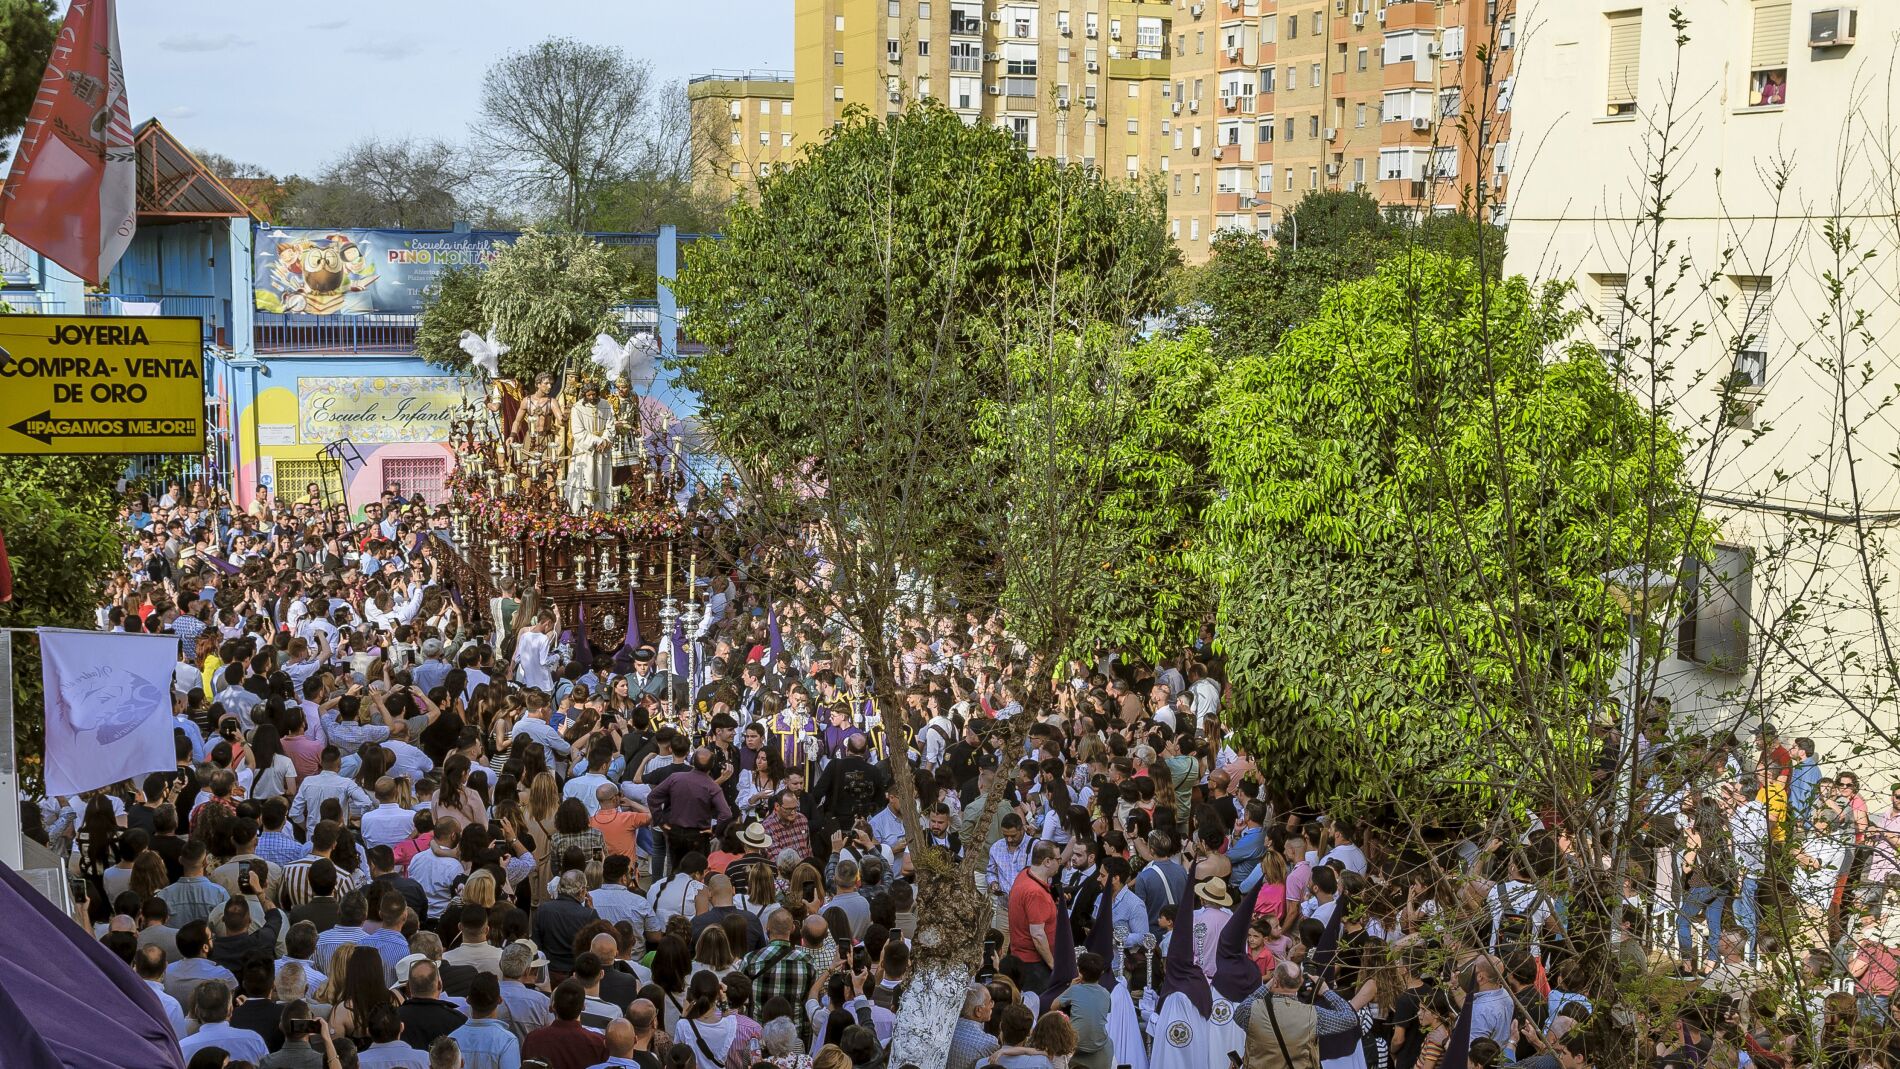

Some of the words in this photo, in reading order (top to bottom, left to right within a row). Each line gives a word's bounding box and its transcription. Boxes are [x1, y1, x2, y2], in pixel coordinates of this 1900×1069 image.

[388, 249, 431, 264] PINO
[433, 250, 502, 264] MONTAN
[411, 239, 451, 250] Escuela
[453, 240, 491, 253] infantil
[48, 325, 150, 346] JOYERIA
[0, 357, 118, 378] COMPRA-
[124, 358, 200, 379] VENTA
[53, 383, 83, 403] DE
[90, 383, 148, 404] ORO
[312, 397, 379, 422] Escuela
[27, 420, 124, 435] !!PAGAMOS
[129, 420, 196, 435] MEJOR!!
